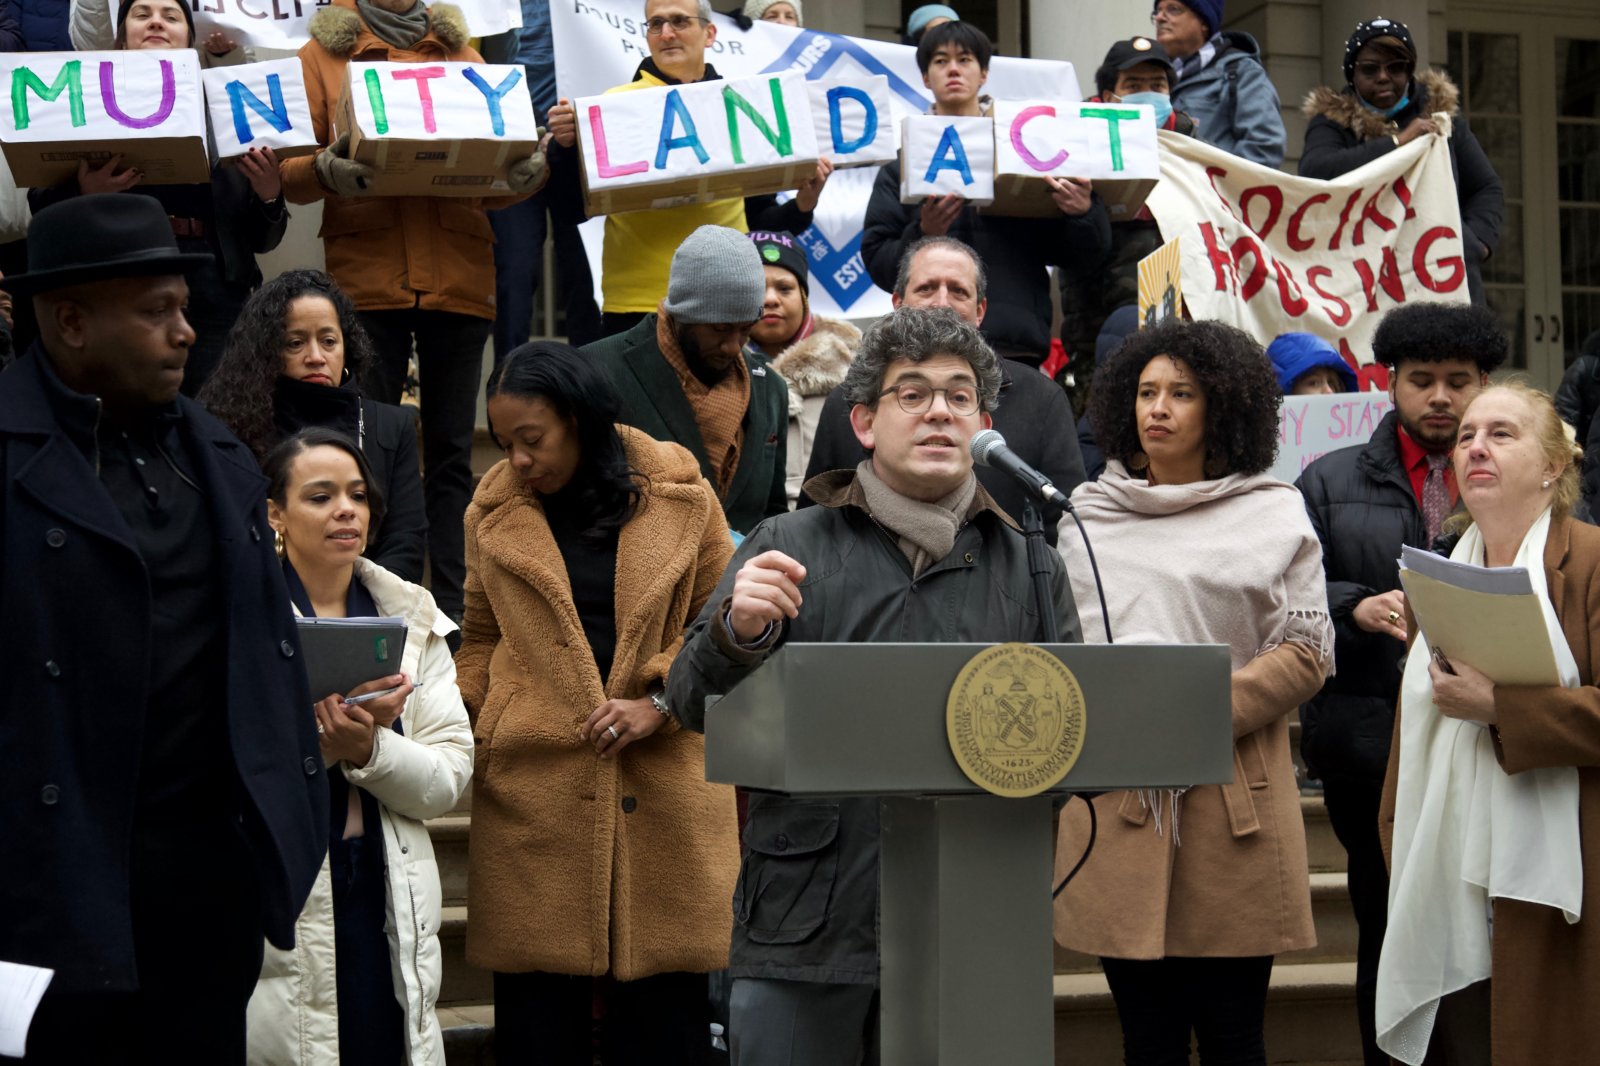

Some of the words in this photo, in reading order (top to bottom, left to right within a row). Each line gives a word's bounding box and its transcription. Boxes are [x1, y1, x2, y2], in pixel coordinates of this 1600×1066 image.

[588, 77, 878, 178] LAND
[923, 106, 1140, 186] ACT
[1198, 222, 1465, 327] HOUSING
